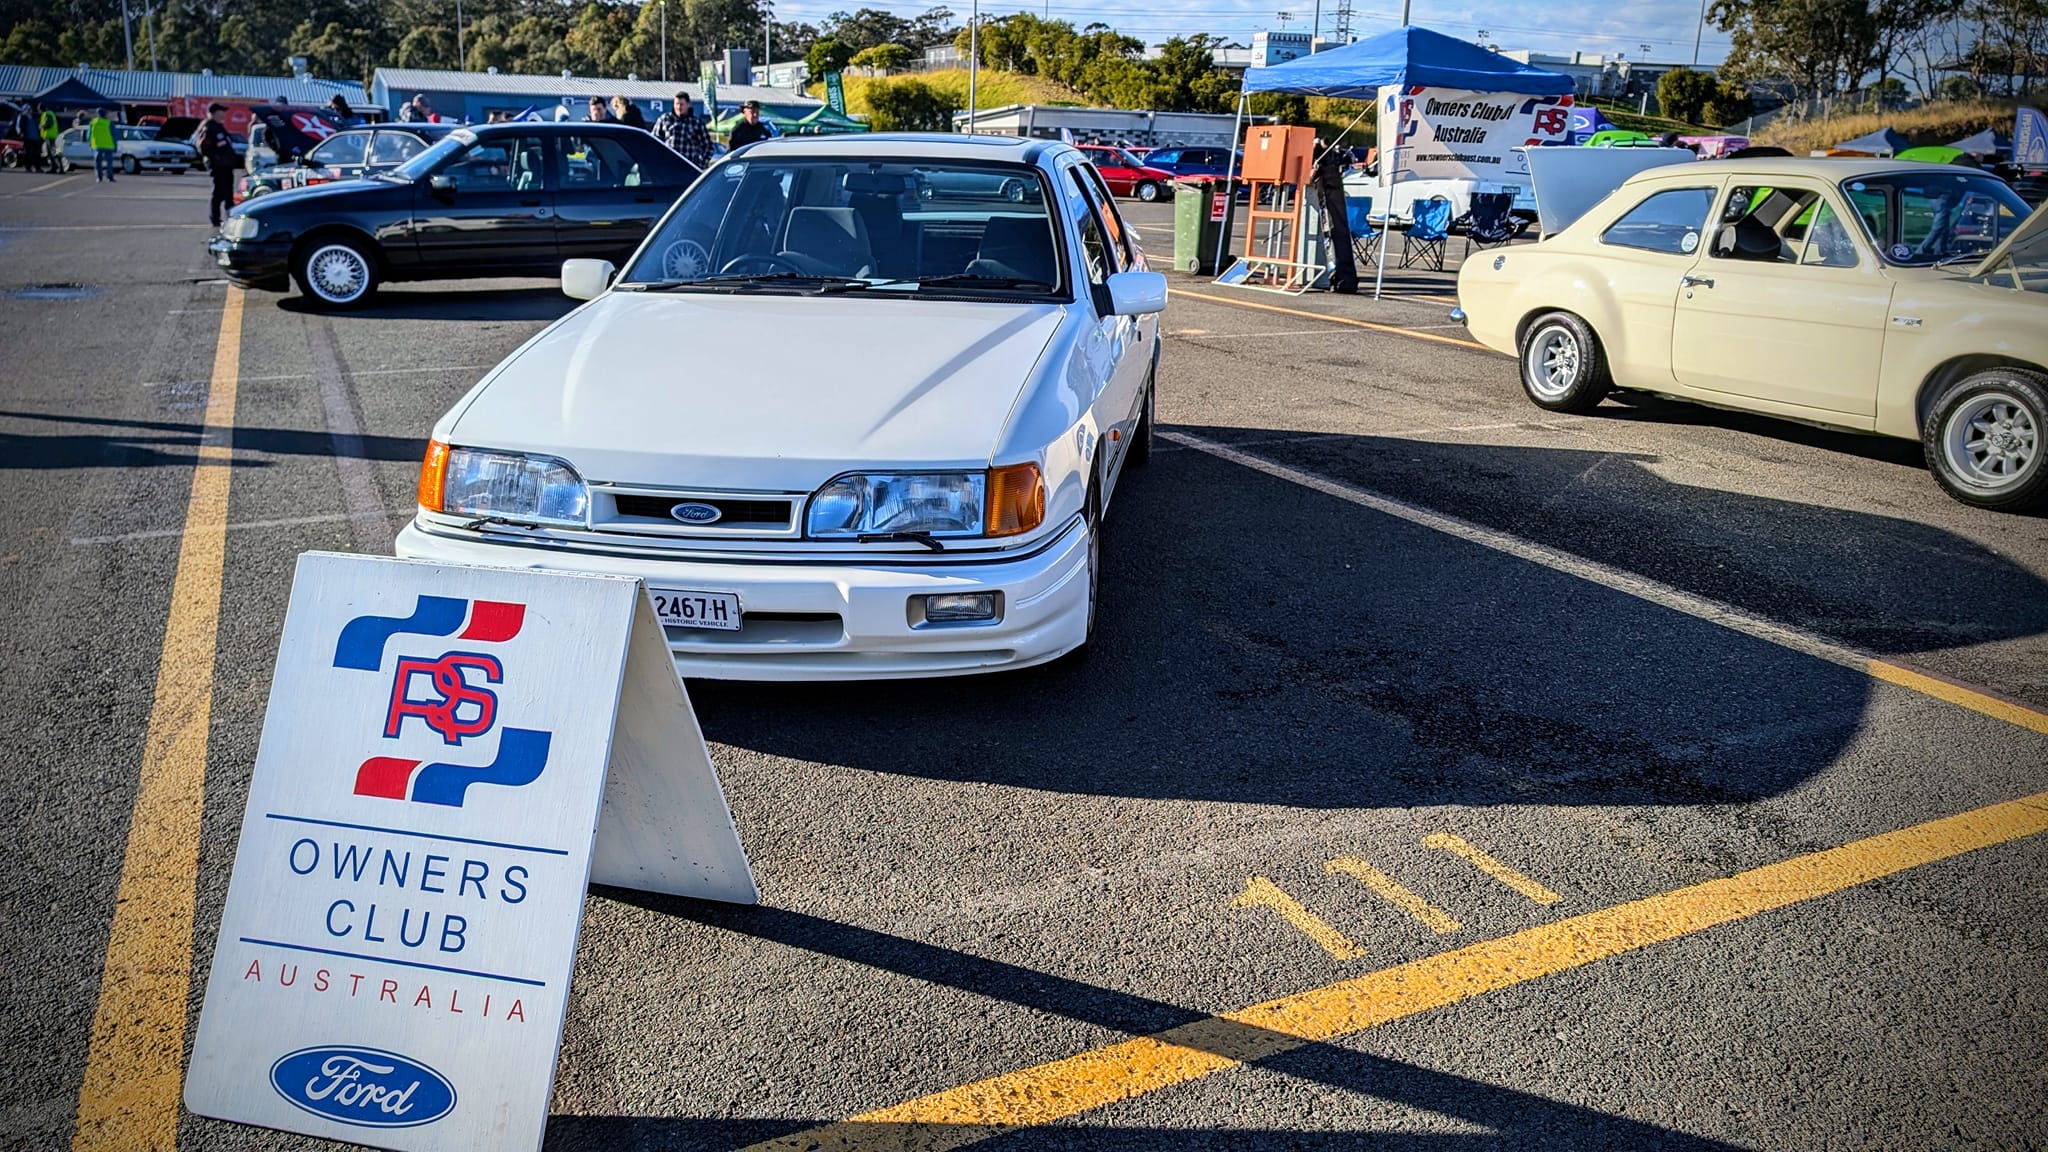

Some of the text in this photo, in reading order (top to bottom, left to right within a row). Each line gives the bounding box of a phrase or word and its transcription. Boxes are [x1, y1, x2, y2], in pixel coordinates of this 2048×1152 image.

[1425, 97, 1471, 118] Owners
[1470, 102, 1505, 121] Club
[1533, 109, 1568, 135] RS
[1433, 124, 1487, 144] Australia
[682, 507, 709, 519] Ford
[664, 617, 729, 628] HISTORIC VEHICLE
[383, 651, 503, 746] RS
[289, 838, 529, 904] OWNERS
[326, 900, 468, 953] CLUB
[245, 958, 525, 1022] AUSTRALIA
[305, 1055, 420, 1115] Ford
